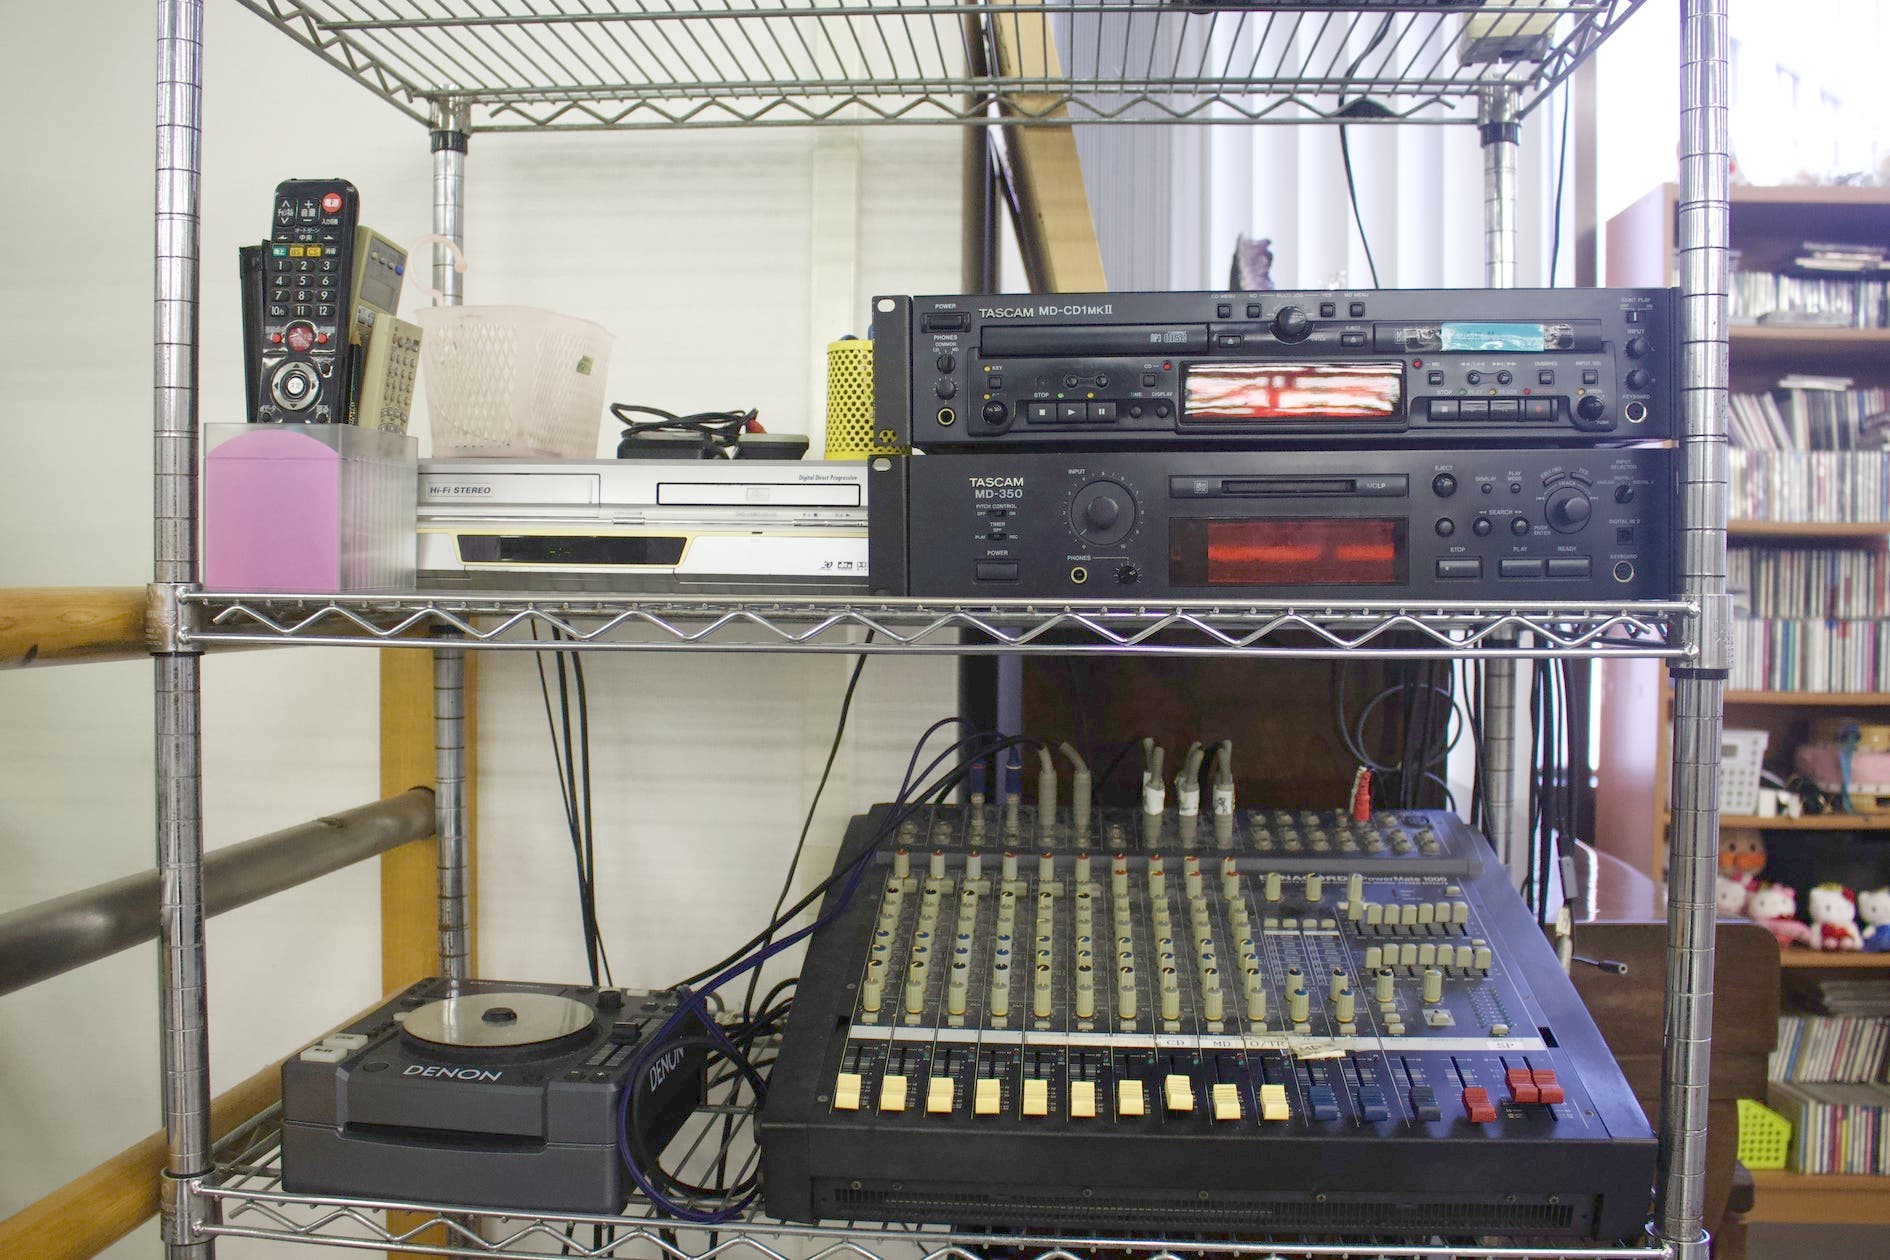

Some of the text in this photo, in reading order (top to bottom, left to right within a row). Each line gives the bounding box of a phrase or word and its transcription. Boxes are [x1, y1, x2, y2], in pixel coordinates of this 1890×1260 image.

[279, 261, 283, 270] 1
[301, 261, 307, 270] 2
[323, 261, 330, 270] 3
[276, 277, 283, 285] 4
[300, 276, 306, 285] 5
[322, 277, 329, 285] 6
[275, 291, 282, 300] 7
[299, 291, 305, 300] 8
[321, 291, 328, 300] 9
[297, 306, 304, 315] 11
[319, 306, 328, 315] 12
[979, 308, 1034, 318] TASCAM
[969, 477, 1024, 487] TASCAM
[430, 486, 491, 494] Hi-Fi STEREO
[975, 489, 1023, 499] MD-350
[402, 1064, 503, 1082] DENON
